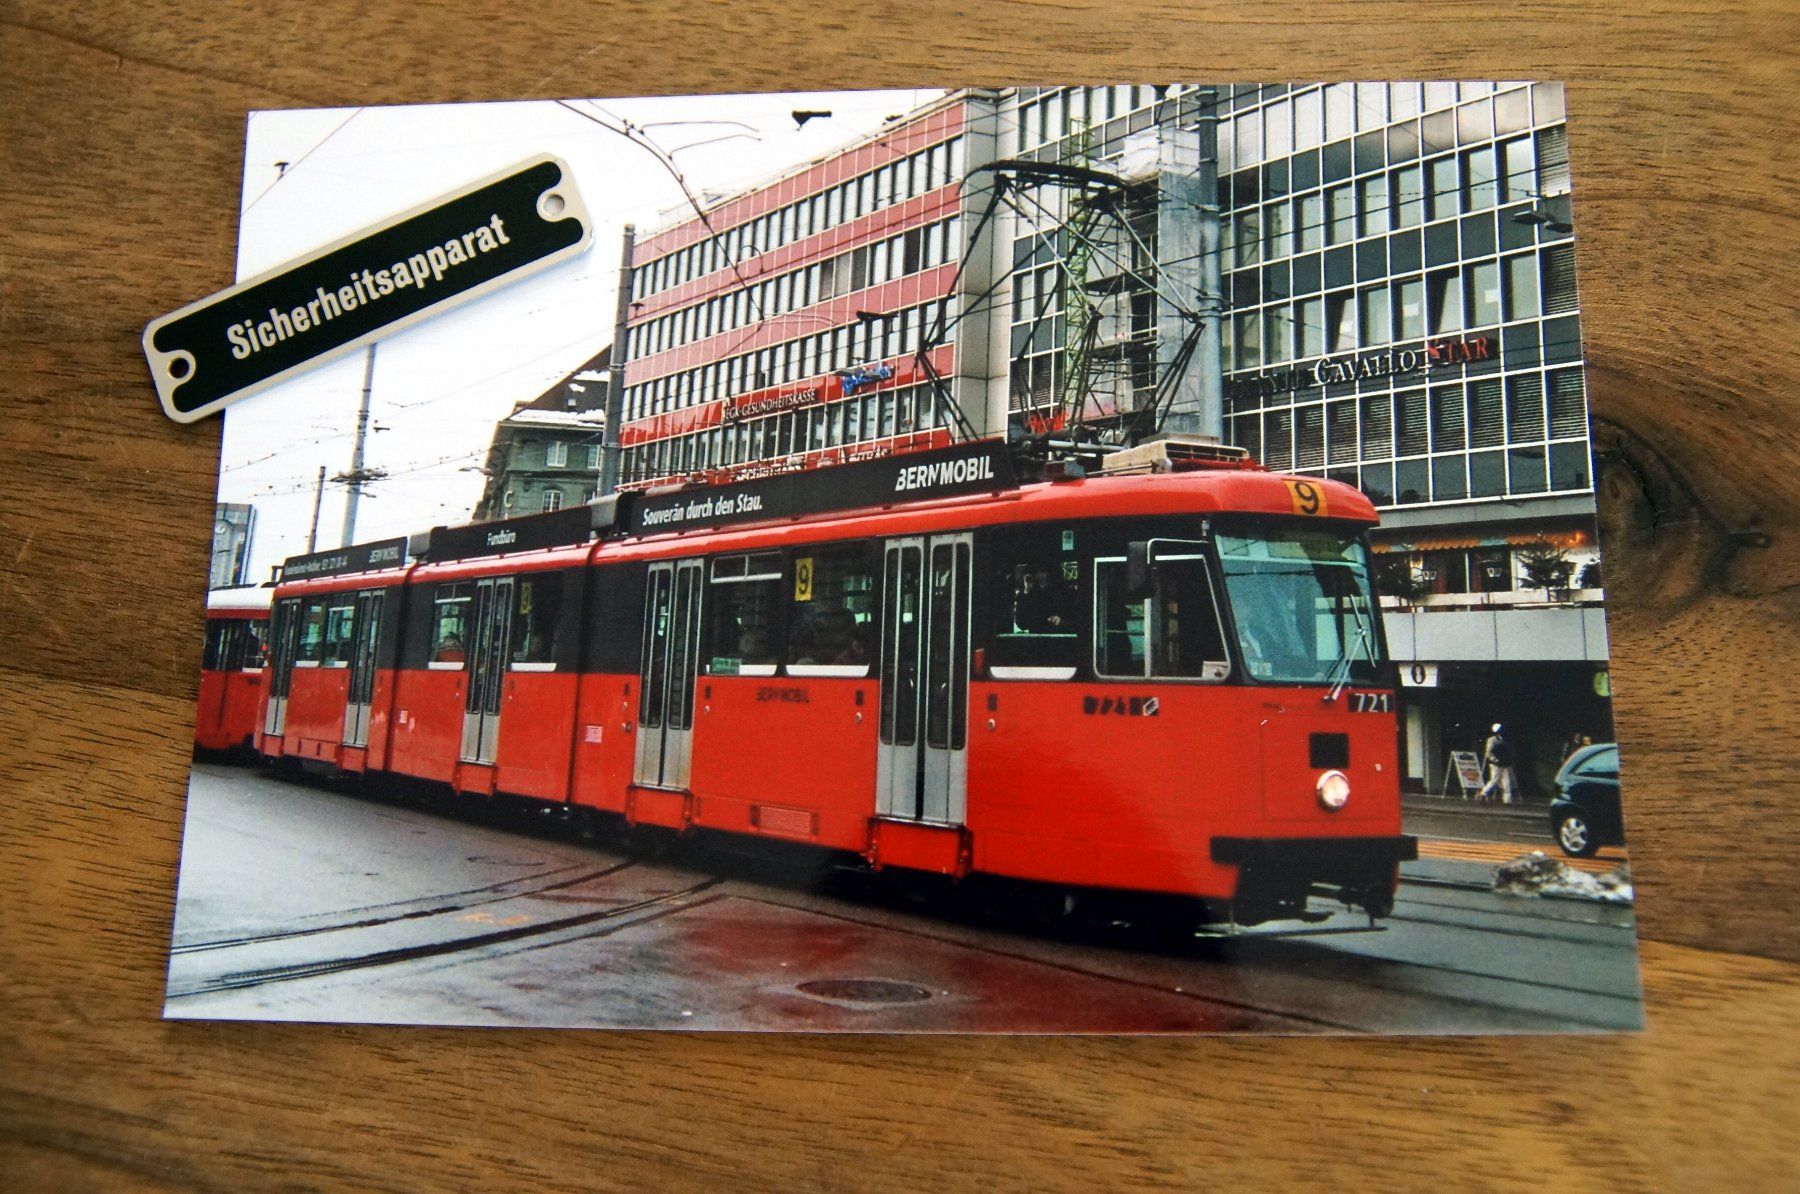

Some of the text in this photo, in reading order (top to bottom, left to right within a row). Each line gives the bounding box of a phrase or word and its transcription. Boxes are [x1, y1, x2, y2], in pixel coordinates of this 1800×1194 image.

[226, 213, 511, 360] Sicherheitsapparat
[1314, 349, 1417, 385] CAVALLO
[895, 455, 994, 491] BERNMOBIL
[642, 493, 763, 526] Souverän durch den Stau.
[1294, 480, 1319, 515] 9
[799, 564, 809, 595] 9
[1354, 692, 1389, 713] 721
